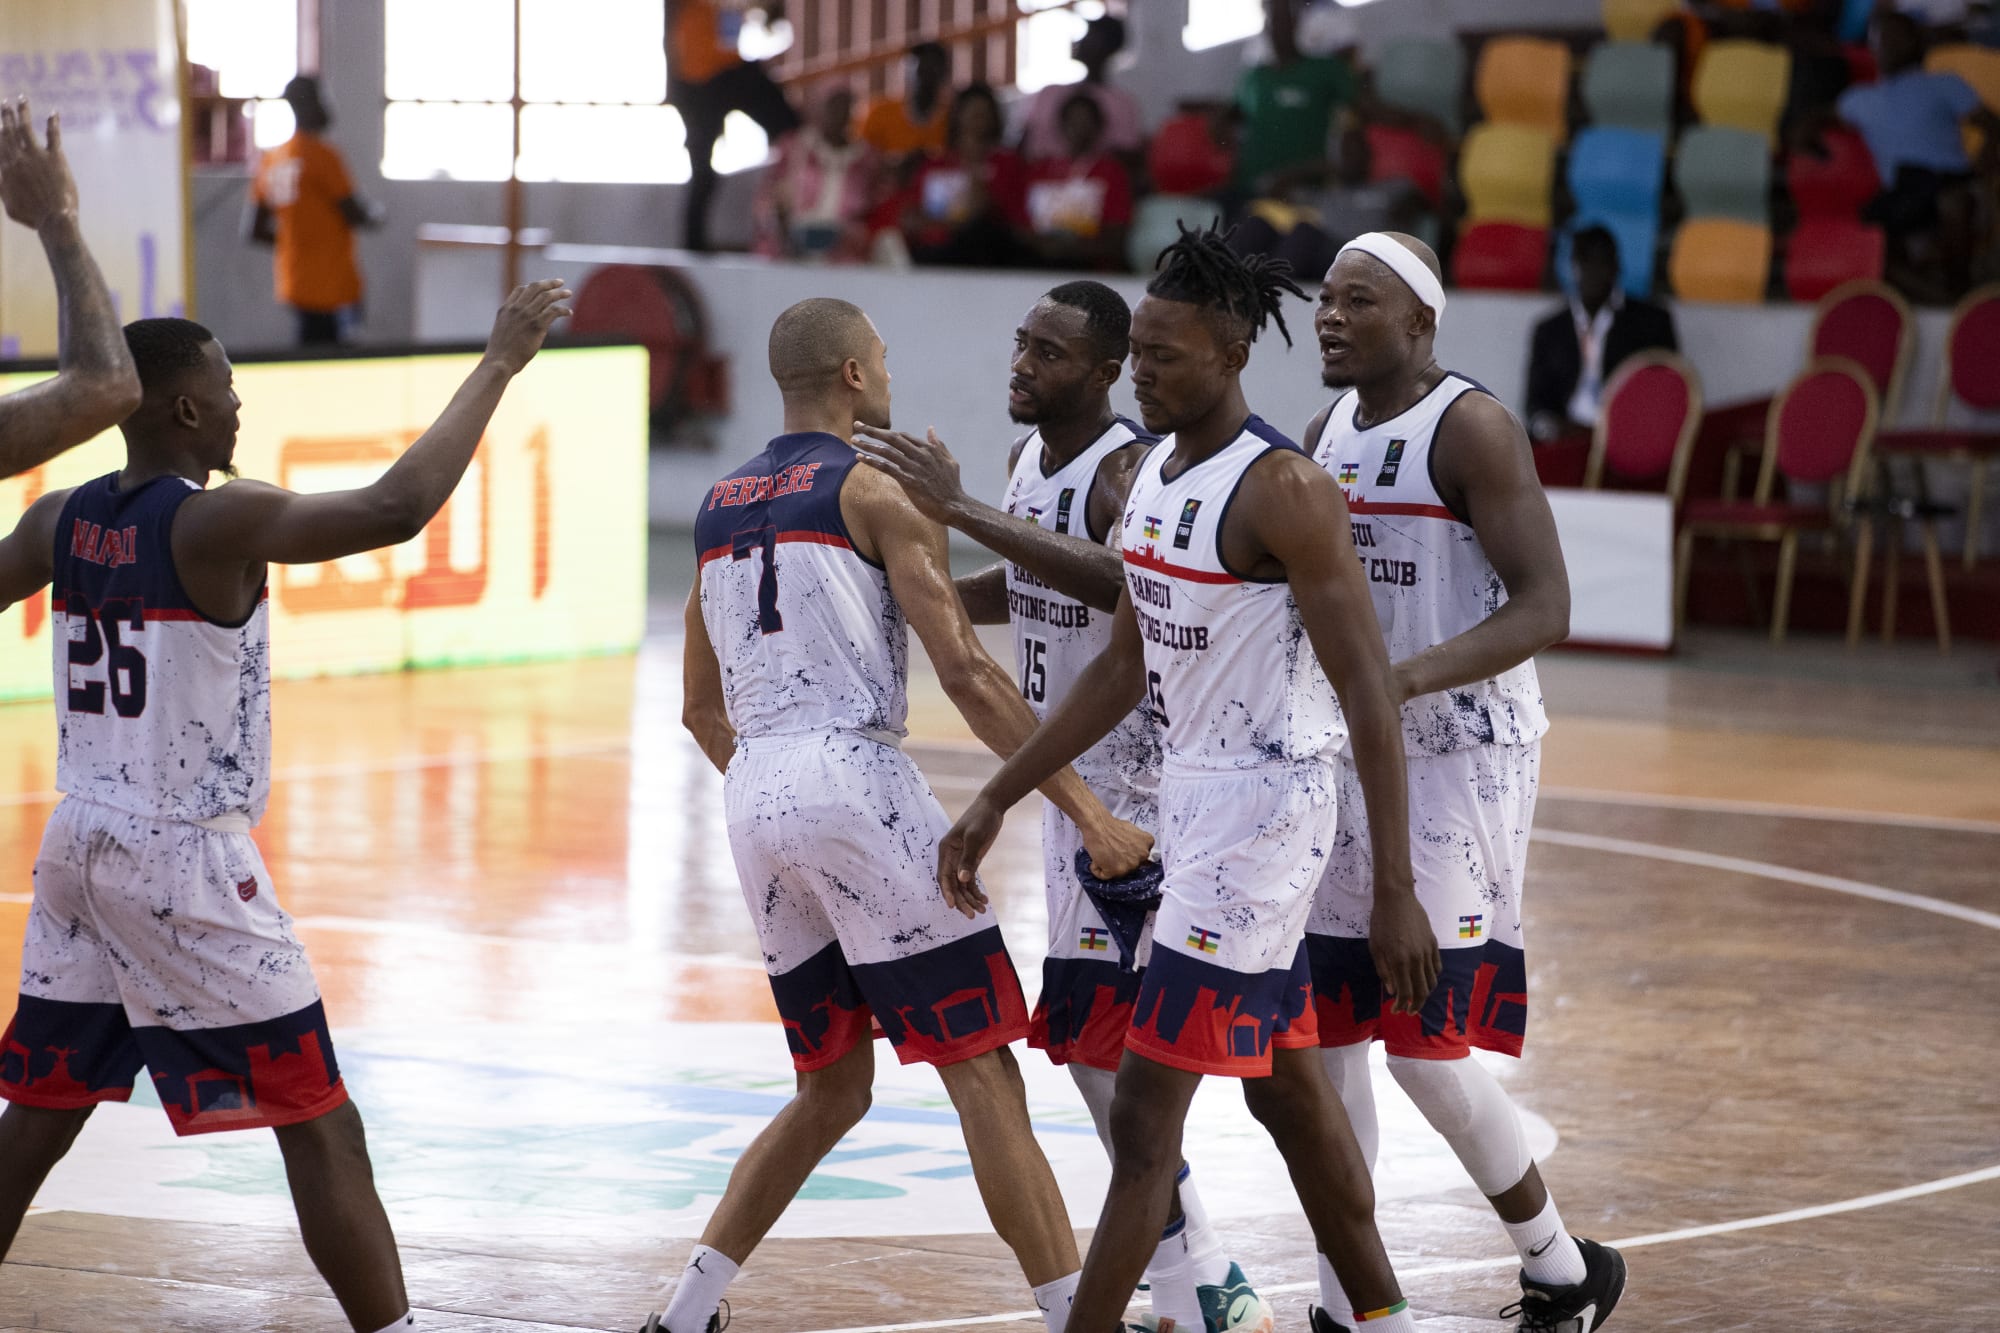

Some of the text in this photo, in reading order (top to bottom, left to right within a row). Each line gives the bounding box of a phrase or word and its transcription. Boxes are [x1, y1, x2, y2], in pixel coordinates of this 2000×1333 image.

[732, 525, 783, 635] 7
[1129, 572, 1171, 610] BANGUI
[1371, 558, 1416, 586] CLUB
[1050, 602, 1089, 628] CLUB
[64, 588, 147, 718] 26
[1163, 622, 1208, 650] CLUB
[1023, 638, 1046, 703] 15
